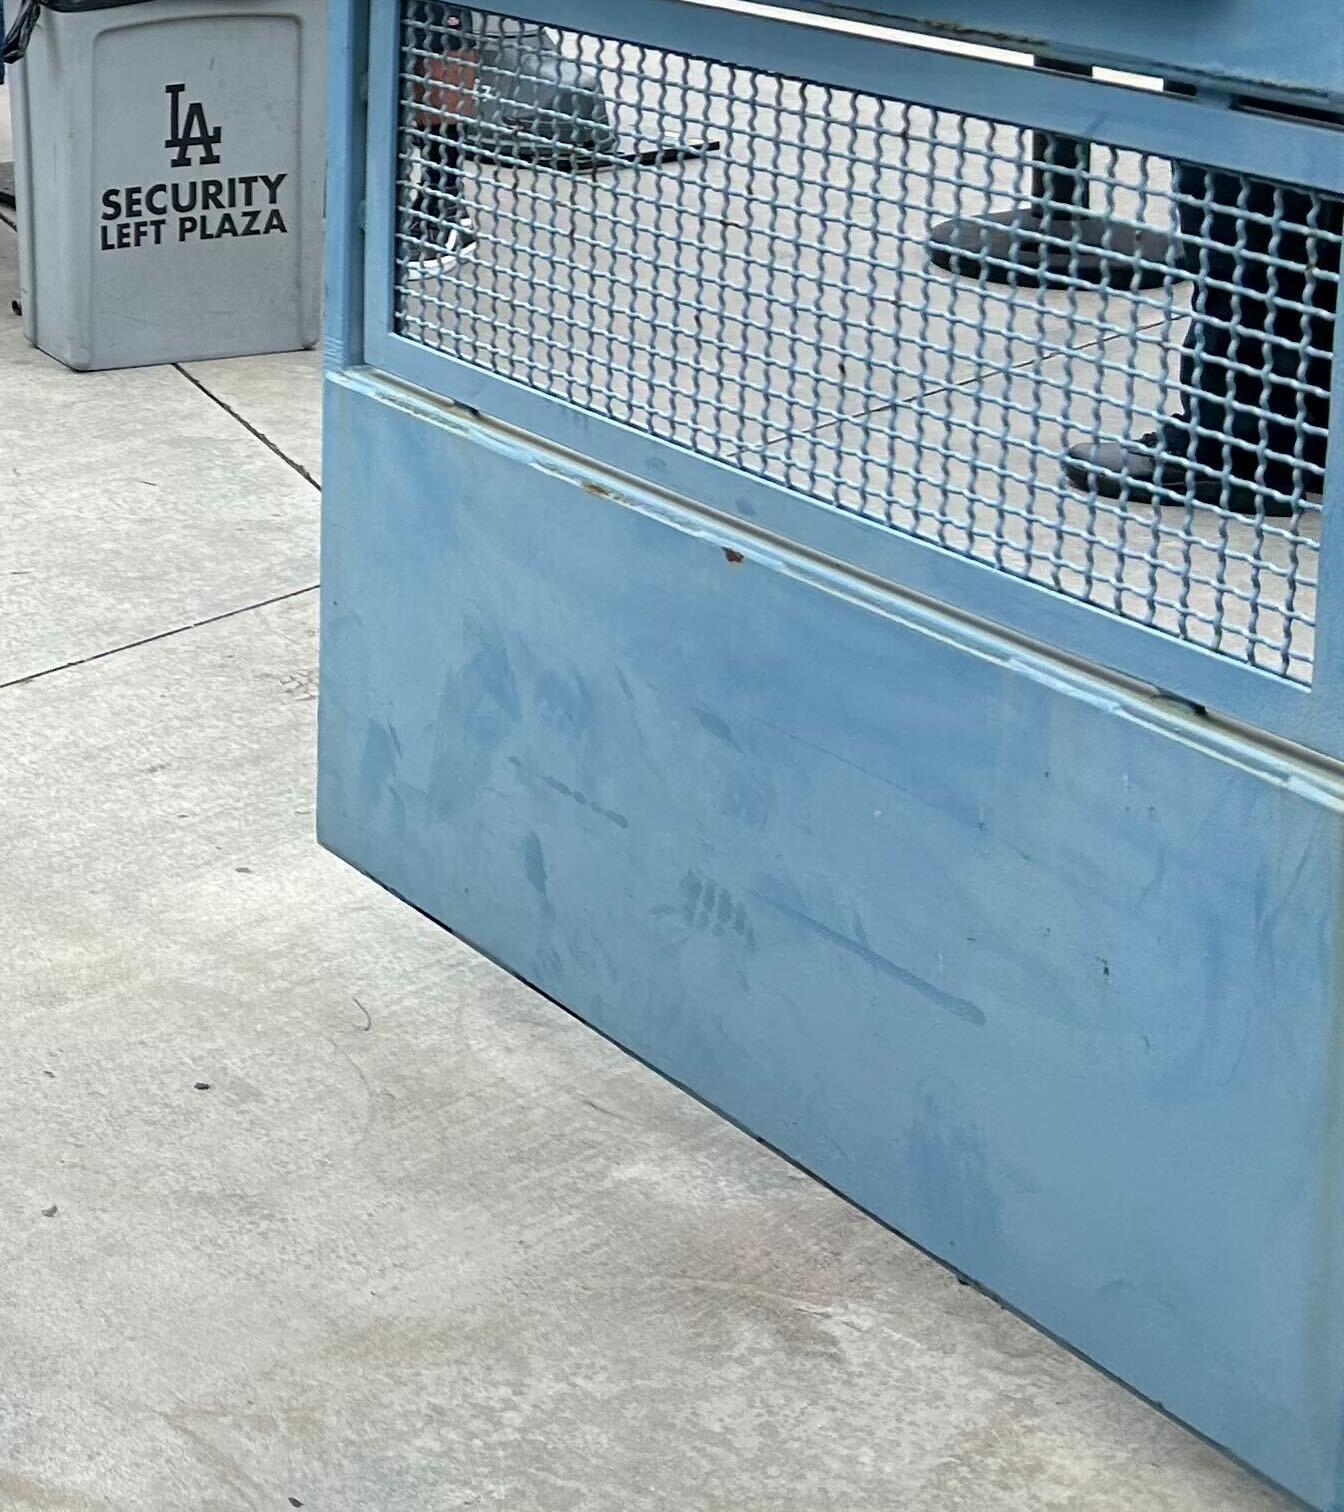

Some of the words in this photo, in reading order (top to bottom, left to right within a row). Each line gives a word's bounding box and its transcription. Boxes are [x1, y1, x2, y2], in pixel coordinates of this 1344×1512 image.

[164, 83, 222, 168] LA
[101, 173, 288, 221] SECURITY
[100, 219, 166, 251] LEFT
[178, 209, 288, 242] PLAZA
